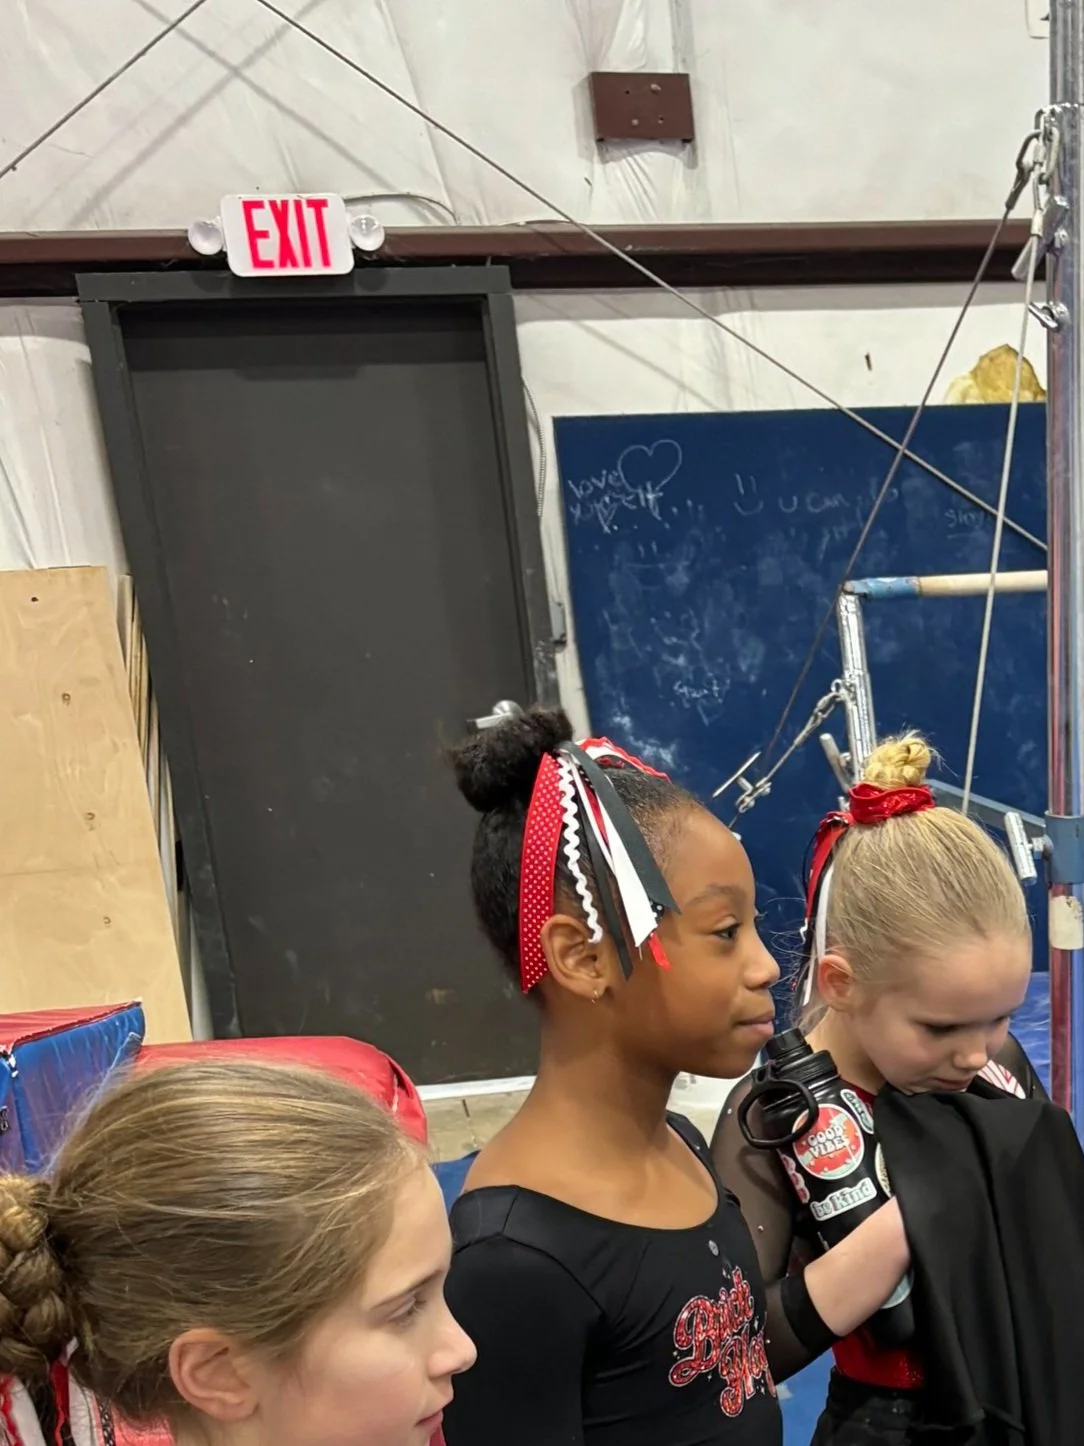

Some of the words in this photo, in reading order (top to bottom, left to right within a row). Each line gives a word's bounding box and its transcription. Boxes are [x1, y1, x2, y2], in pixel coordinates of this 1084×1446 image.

[241, 198, 332, 269] EXIT
[806, 1124, 844, 1147] GOOD
[809, 1137, 848, 1159] VIBES
